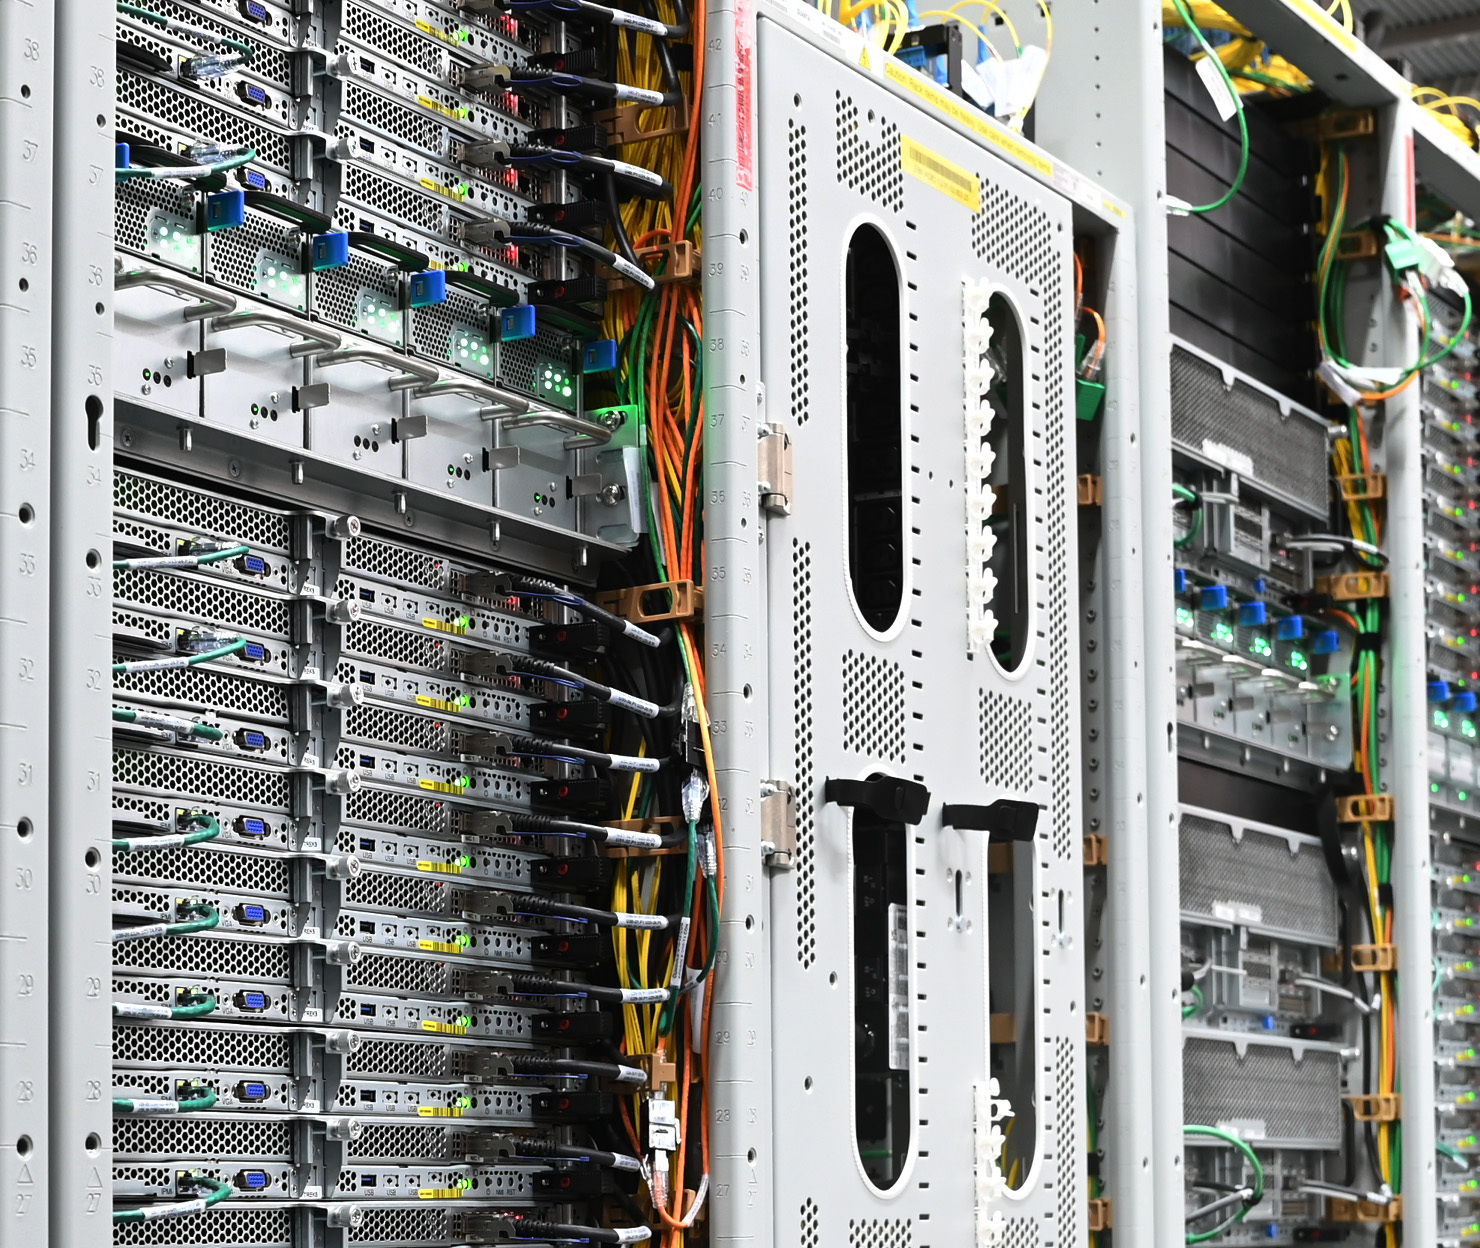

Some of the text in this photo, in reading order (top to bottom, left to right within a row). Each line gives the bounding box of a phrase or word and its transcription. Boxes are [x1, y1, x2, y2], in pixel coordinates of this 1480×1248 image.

[24, 38, 40, 62] 38
[708, 38, 722, 51] 42
[90, 65, 106, 88] 38
[708, 114, 721, 126] 41
[22, 140, 38, 162] 37
[88, 164, 104, 185] 37
[708, 188, 723, 200] 40
[22, 242, 38, 266] 36
[88, 264, 104, 286] 36
[709, 263, 723, 276] 39
[20, 345, 37, 368] 35
[709, 339, 724, 352] 38
[88, 364, 103, 387] 35
[710, 414, 724, 428] 37
[20, 448, 36, 470] 34
[87, 465, 102, 486] 34
[20, 552, 36, 576] 33
[711, 567, 726, 580] 35
[87, 576, 102, 598] 33
[712, 644, 726, 657] 34
[19, 658, 34, 682] 32
[86, 668, 102, 691] 32
[712, 721, 728, 735] 33
[20, 763, 32, 787] 31
[86, 770, 100, 792] 31
[16, 867, 33, 891] 30
[85, 874, 102, 895] 30
[17, 974, 33, 998] 29
[86, 977, 102, 999] 29
[716, 1031, 730, 1044] 29
[17, 1080, 34, 1104] 28
[86, 1080, 102, 1102] 28
[716, 1110, 731, 1123] 28
[716, 1184, 730, 1197] 27
[16, 1193, 32, 1217] 27
[86, 1193, 102, 1216] 27
